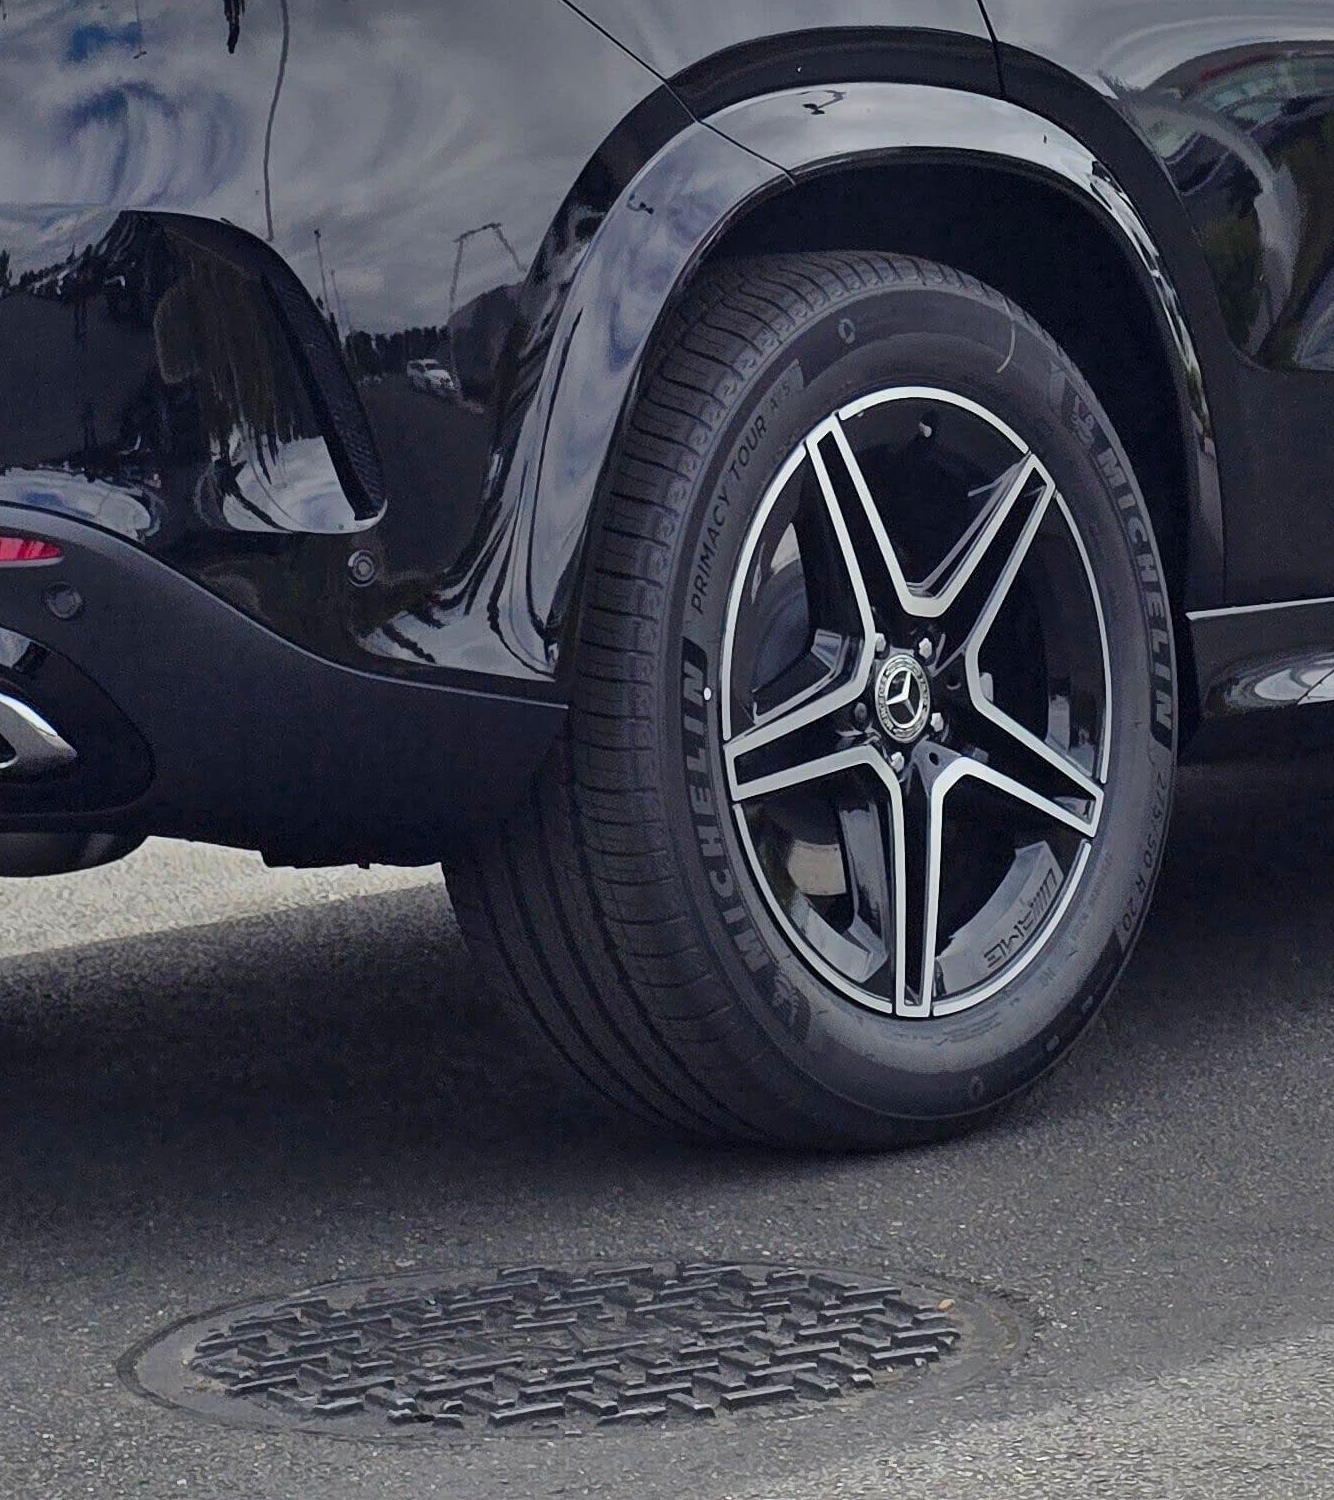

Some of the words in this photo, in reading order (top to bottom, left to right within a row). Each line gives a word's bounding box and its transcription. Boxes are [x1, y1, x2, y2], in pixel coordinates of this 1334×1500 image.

[690, 492, 732, 615] PRIMACY
[727, 414, 768, 482] TOUR
[1097, 447, 1175, 730] MICHELIN
[683, 658, 769, 973] MICHELIN
